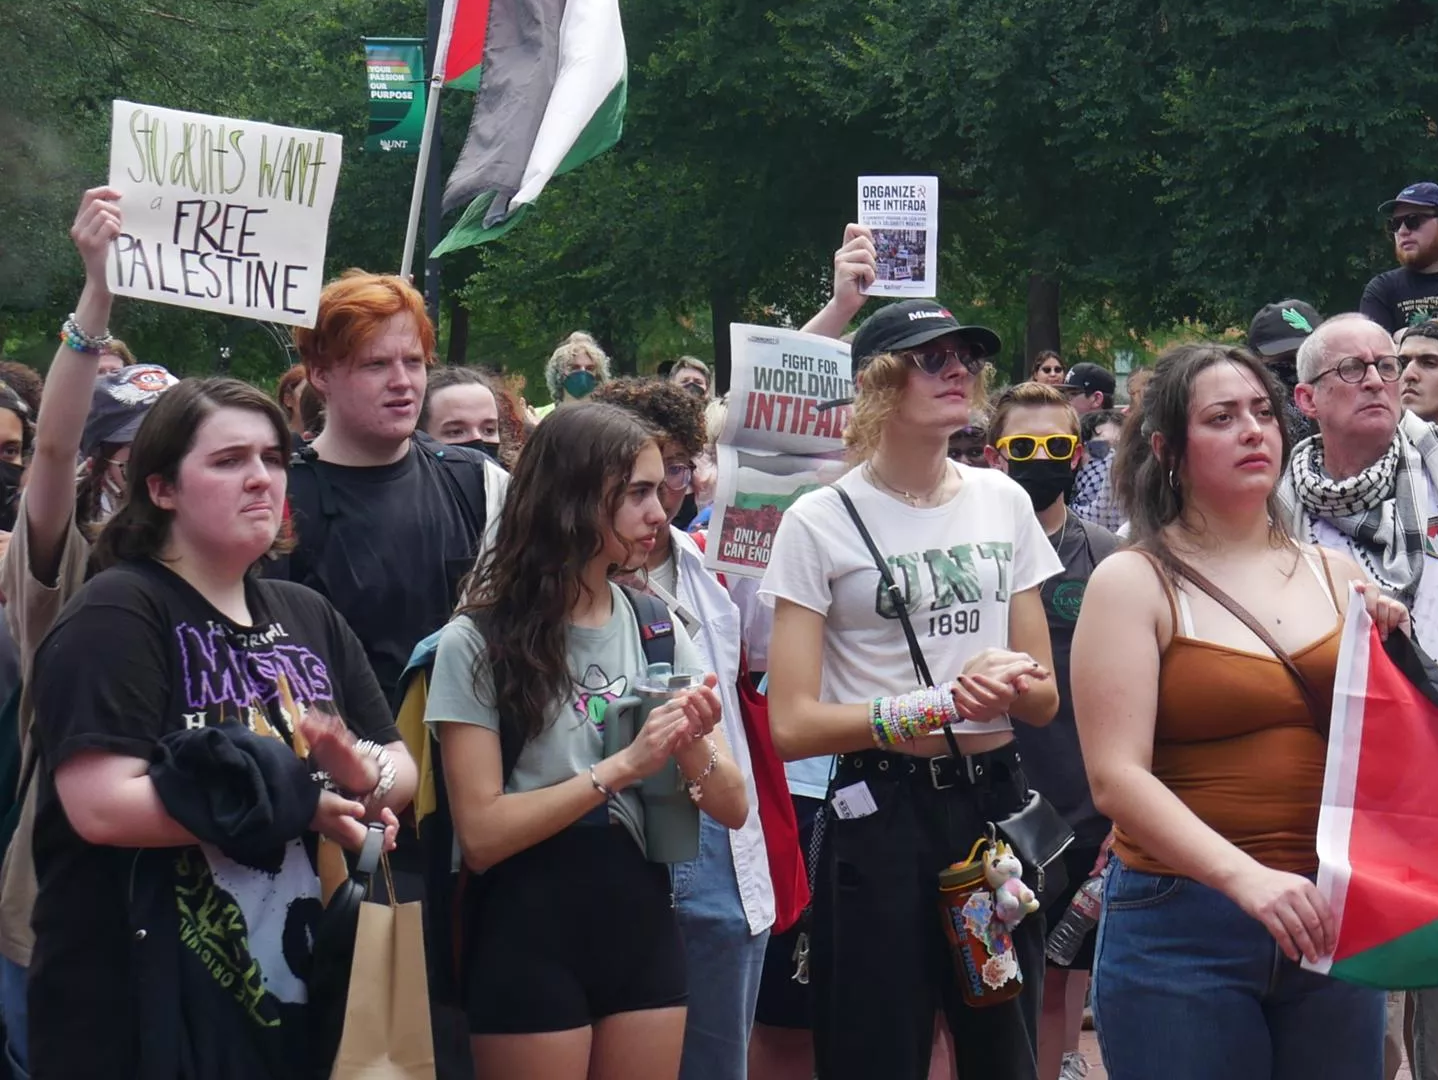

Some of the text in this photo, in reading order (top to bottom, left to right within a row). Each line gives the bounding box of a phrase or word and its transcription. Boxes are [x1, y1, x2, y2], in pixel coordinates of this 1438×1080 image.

[370, 82, 387, 90] OUR
[370, 91, 413, 99] PURPOSE
[862, 185, 916, 199] ORGANIZE
[863, 199, 926, 212] THE INTIFADA
[173, 199, 269, 258] FREE
[112, 232, 308, 315] PALESTINE
[781, 353, 815, 372] FIGHT
[817, 358, 839, 376] FOR
[733, 527, 772, 548] ONLY A
[723, 542, 770, 563] CAN END
[875, 541, 1014, 619] UNT
[927, 609, 981, 638] 1890
